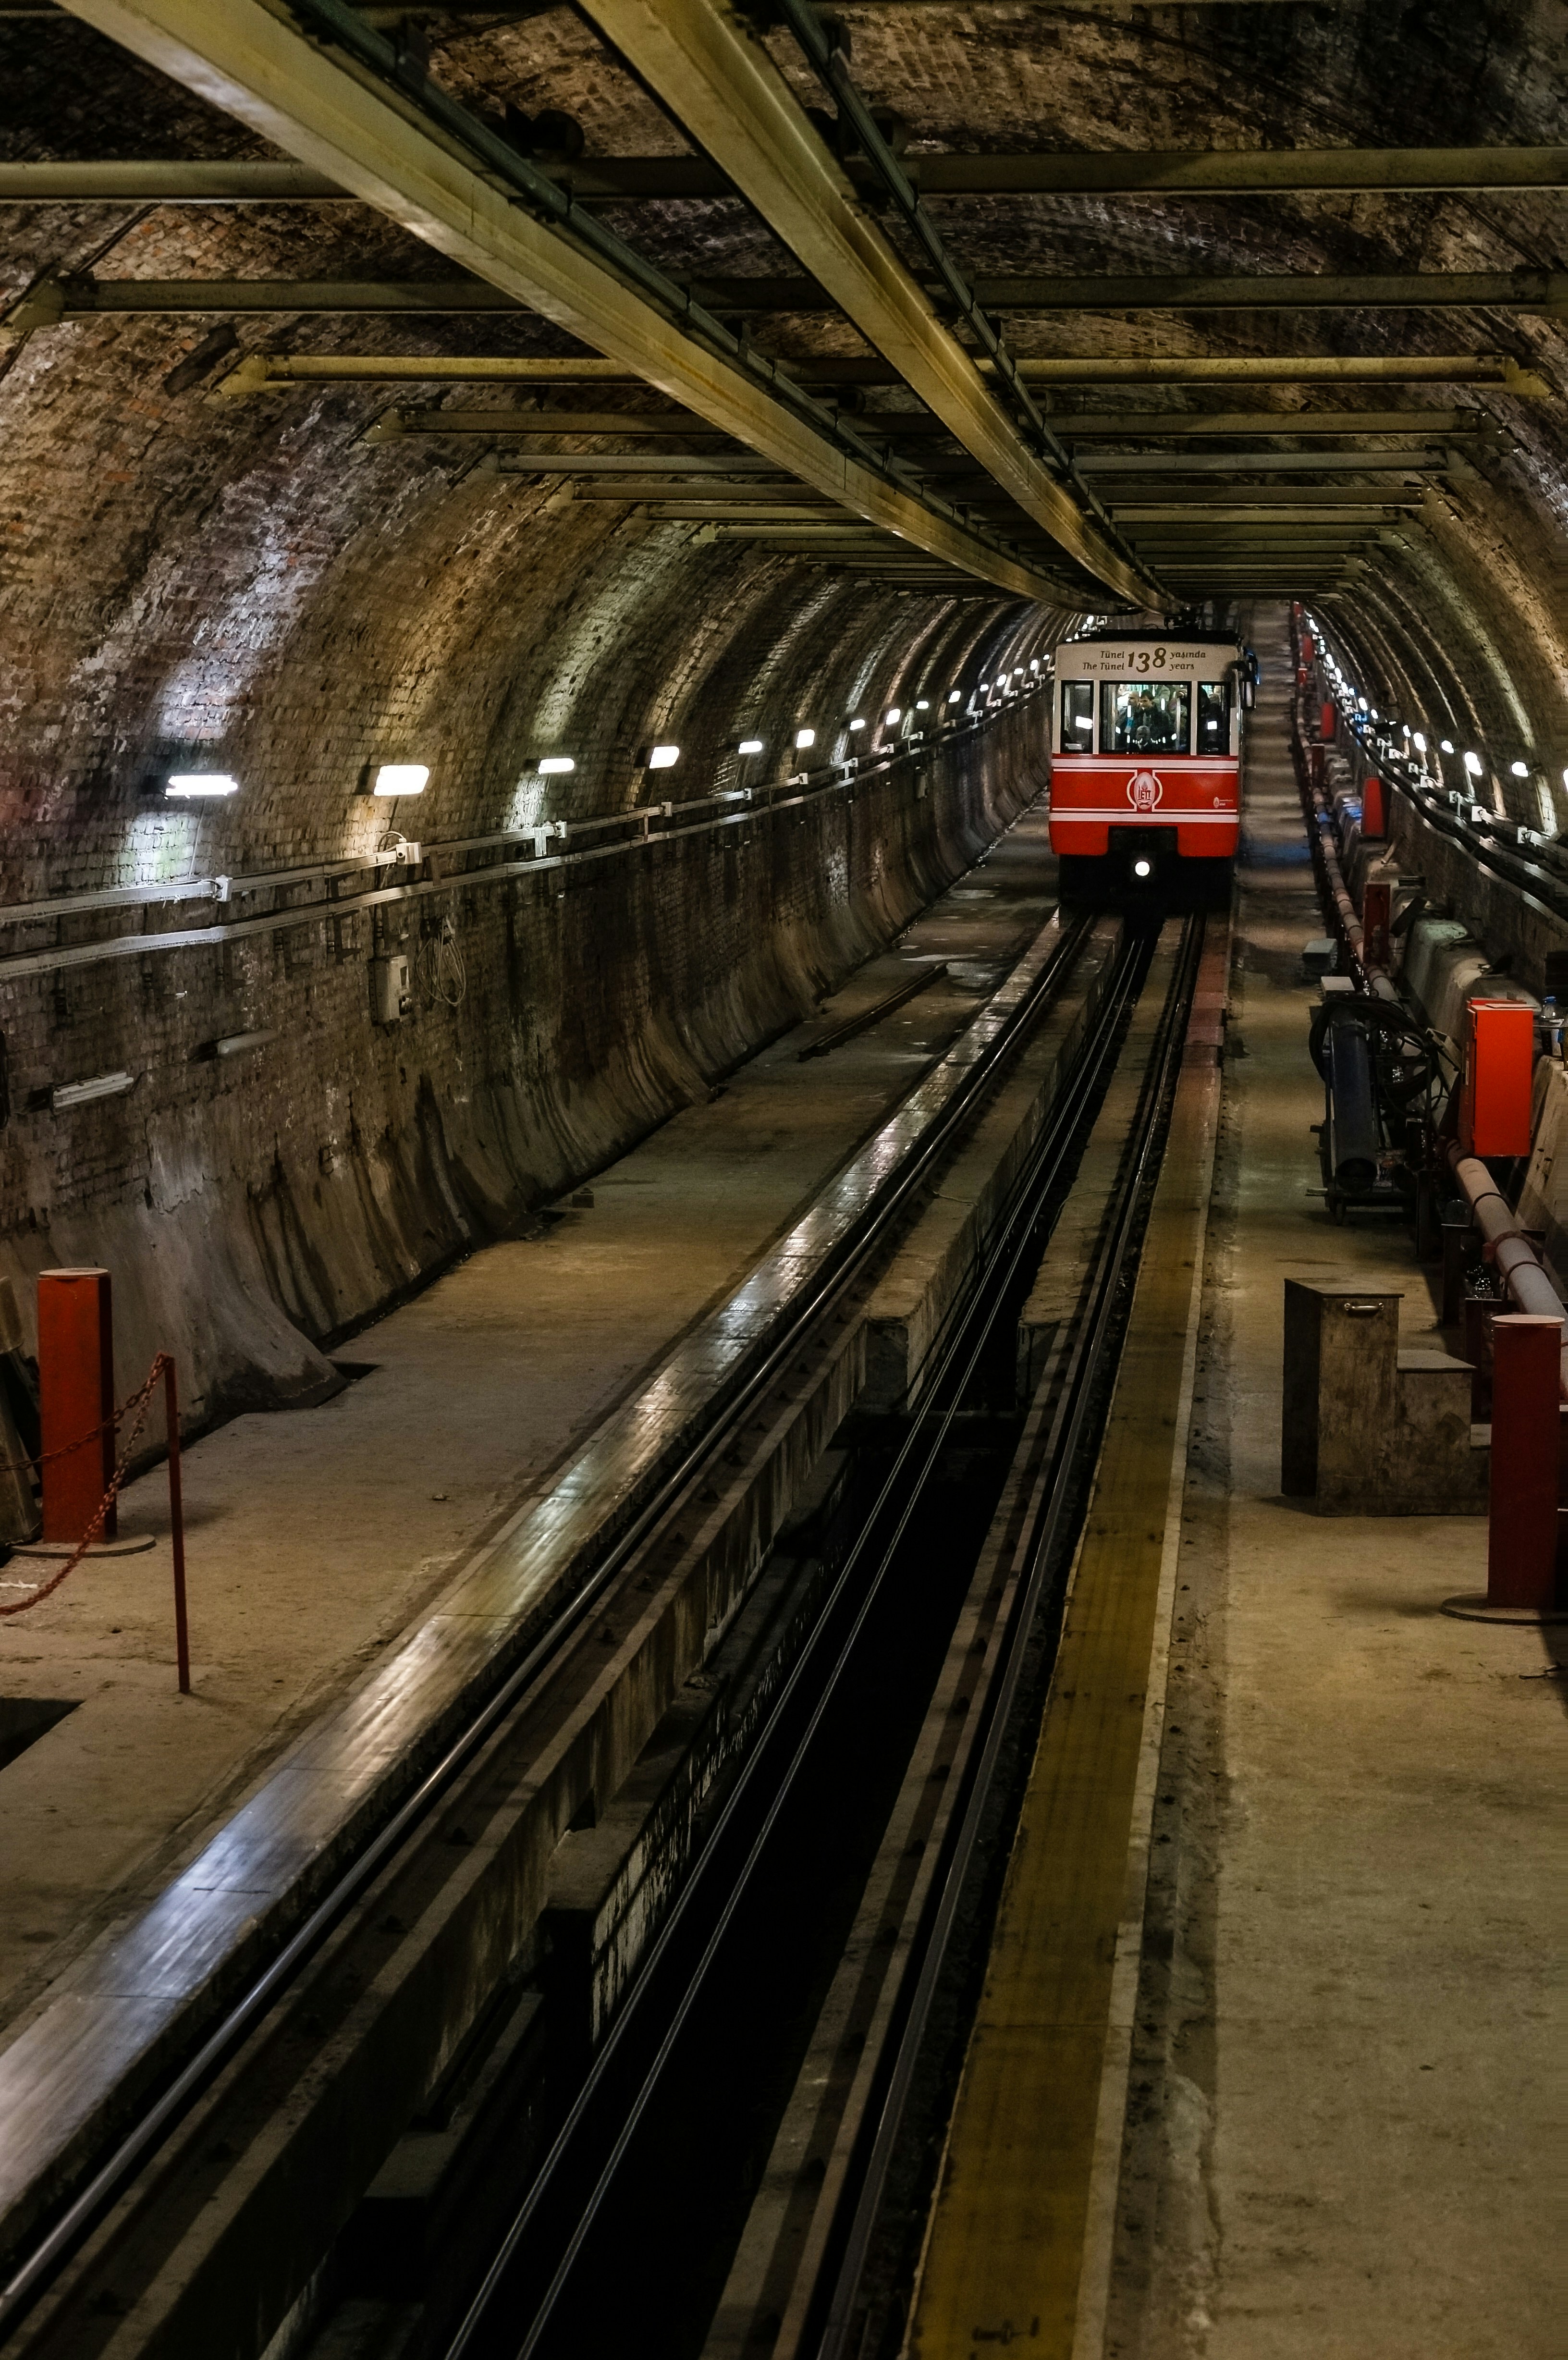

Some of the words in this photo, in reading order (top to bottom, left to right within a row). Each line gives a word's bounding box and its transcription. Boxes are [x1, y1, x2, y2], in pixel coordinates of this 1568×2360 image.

[1082, 662, 1097, 670] The
[1100, 662, 1125, 670] Tünel
[1169, 663, 1195, 671] years
[1100, 650, 1125, 659] Tünel
[1128, 647, 1166, 673] 138
[1169, 650, 1206, 660] yaşında
